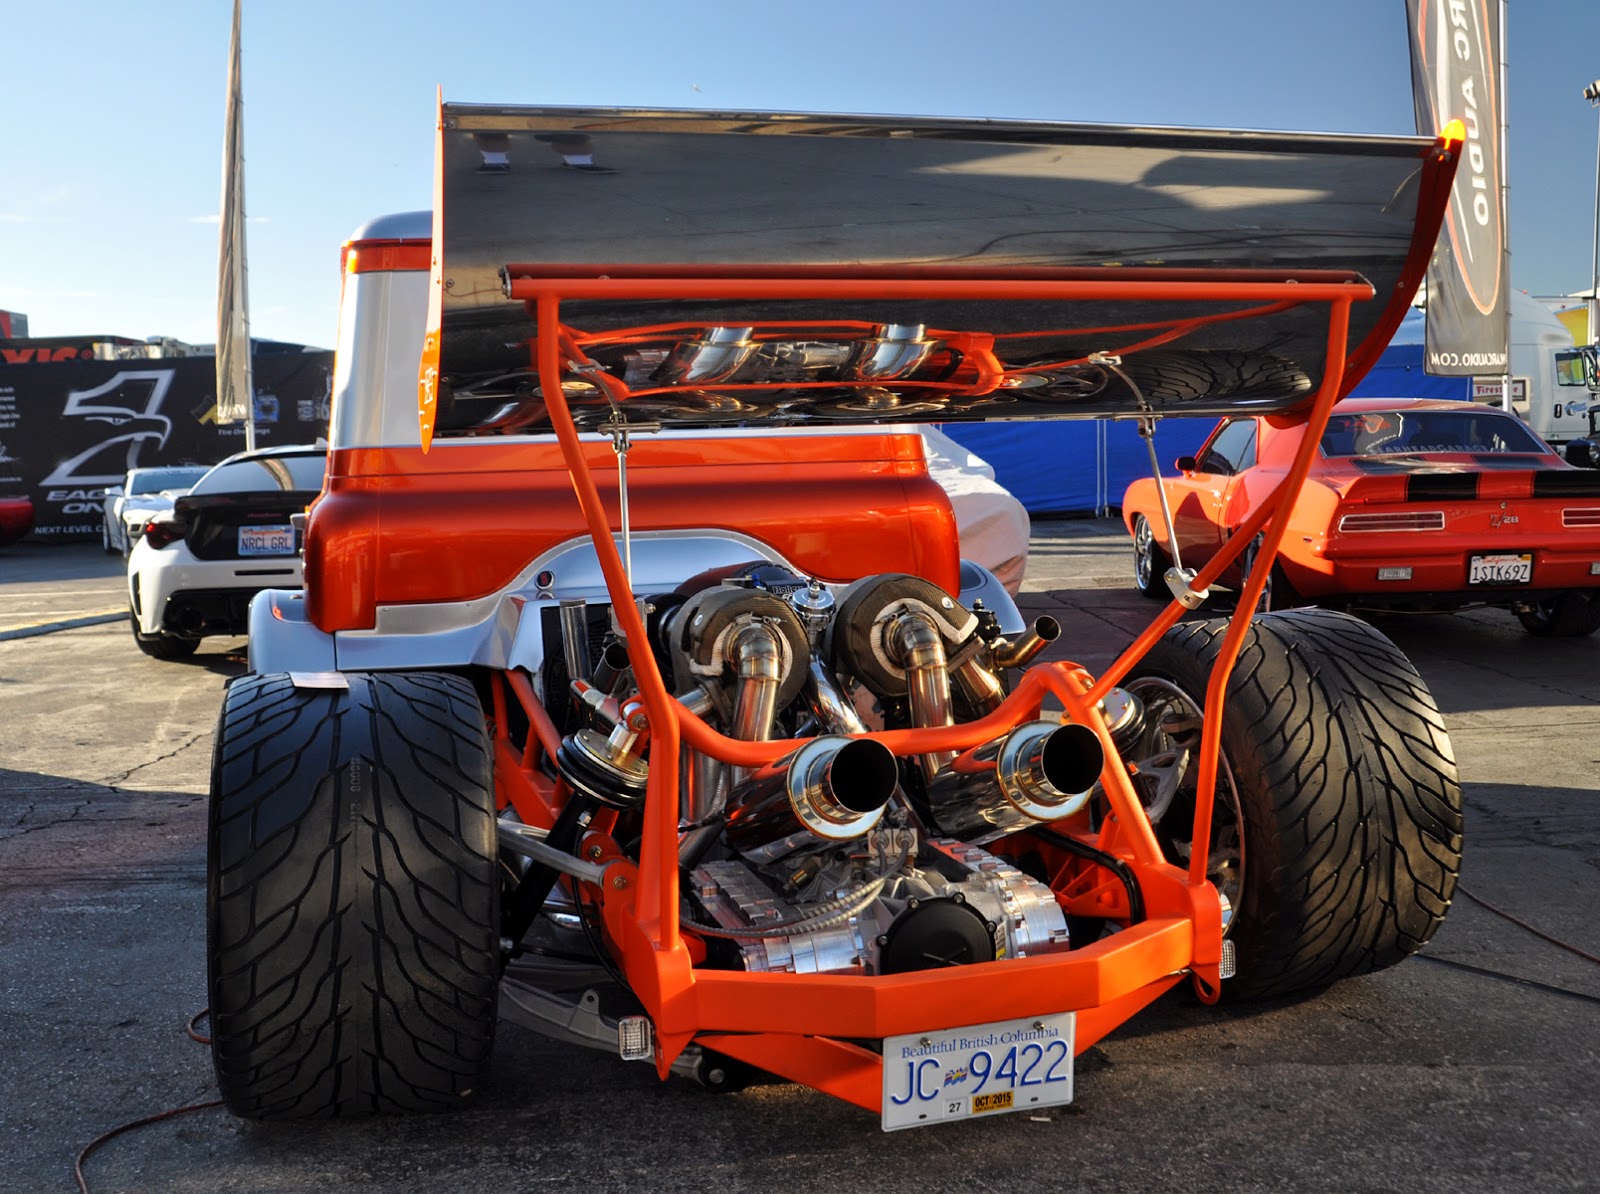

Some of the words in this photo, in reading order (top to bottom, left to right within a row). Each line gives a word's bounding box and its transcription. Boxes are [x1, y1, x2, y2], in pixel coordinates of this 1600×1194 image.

[1476, 385, 1518, 395] Fireste
[46, 490, 106, 501] EAG
[62, 502, 104, 514] ON
[34, 526, 60, 534] NEXT
[63, 524, 93, 534] LEVEL
[241, 537, 268, 551] NRCL
[271, 536, 292, 550] GRL
[901, 1042, 956, 1059] Beautiful
[959, 1032, 998, 1050] British
[1000, 1026, 1059, 1044] Columbia
[891, 1058, 941, 1105] JC
[967, 1040, 1069, 1095] 9422
[975, 1095, 990, 1107] OCT
[993, 1091, 1011, 1104] 2015
[948, 1102, 961, 1113] 27
